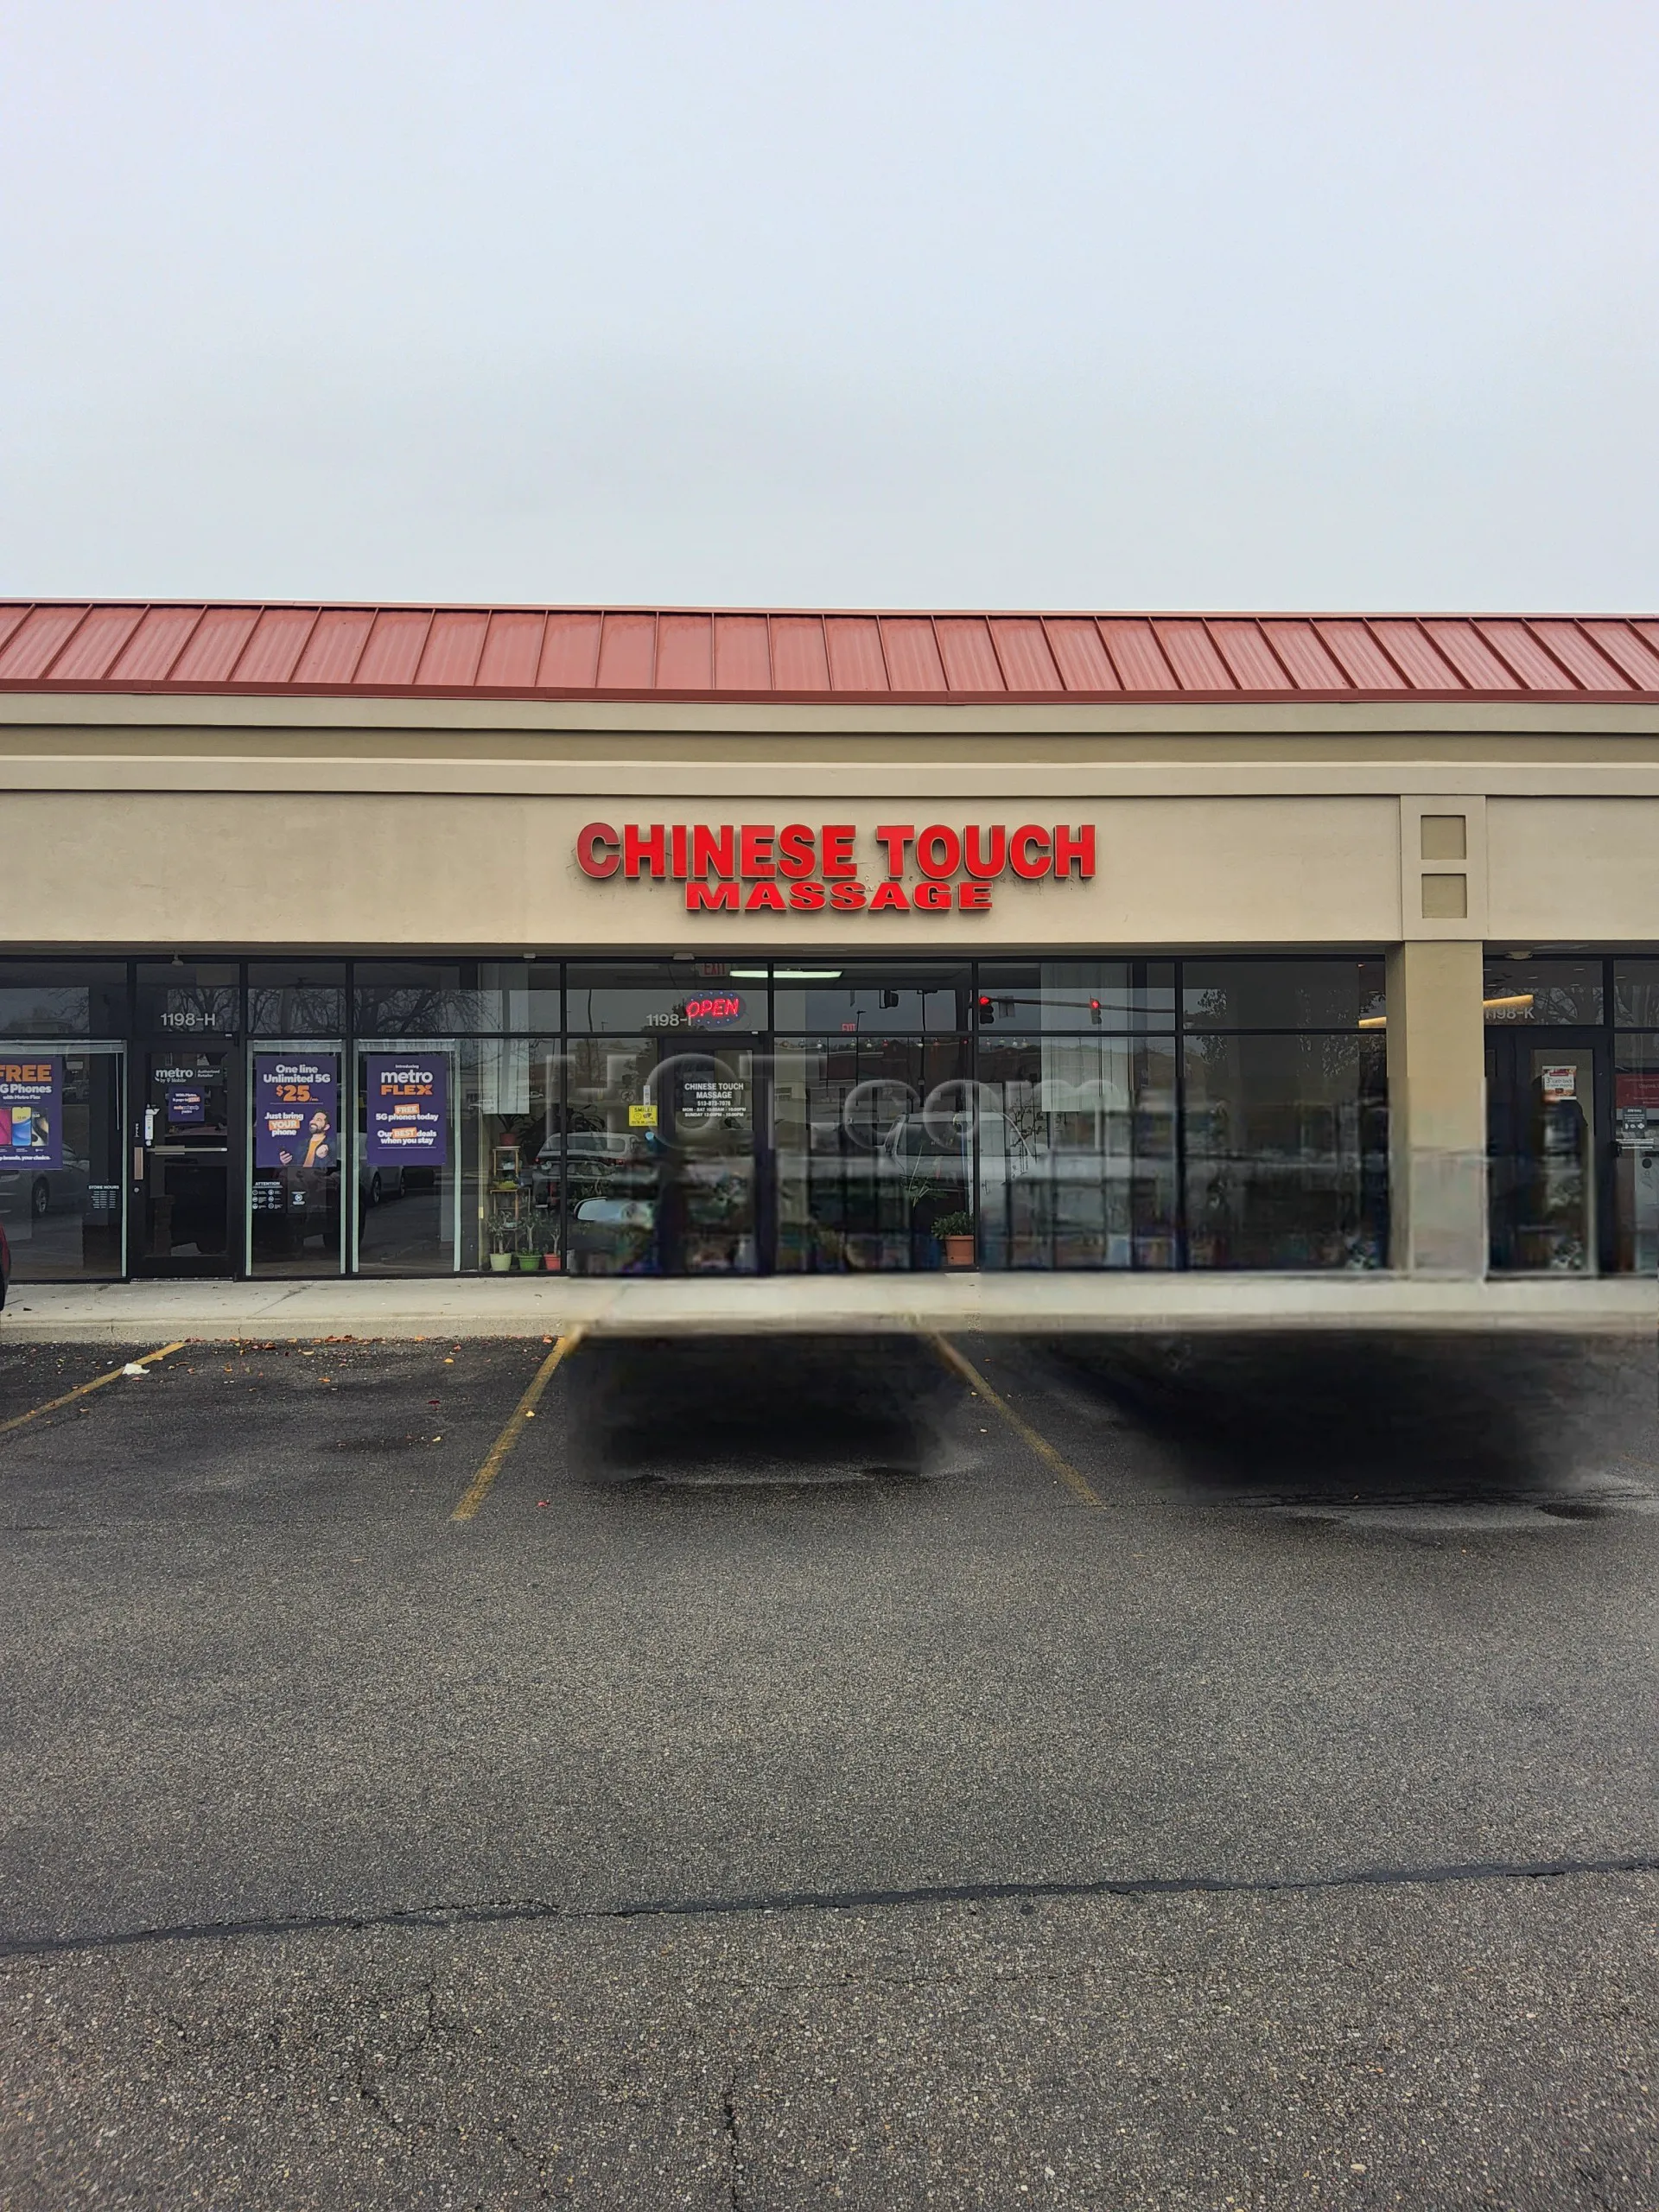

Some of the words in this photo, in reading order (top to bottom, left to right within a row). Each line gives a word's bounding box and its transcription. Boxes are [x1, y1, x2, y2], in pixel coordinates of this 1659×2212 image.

[576, 823, 858, 879] CHINESE
[875, 823, 1096, 880] TOUCH
[685, 881, 994, 911] MASSAGE
[686, 998, 740, 1017] OPEN
[1485, 1007, 1535, 1020] 1198-K
[160, 1013, 216, 1027] 1198-H
[156, 1068, 194, 1077] metro
[276, 1064, 298, 1073] One
[299, 1064, 319, 1073] line
[263, 1074, 313, 1084] Unlimited
[315, 1074, 331, 1083] 5G
[381, 1070, 433, 1084] metro
[10, 1084, 52, 1094] Phones
[276, 1084, 310, 1102] $25
[381, 1084, 433, 1096] FLEX
[283, 1112, 304, 1121] bring
[416, 1113, 439, 1122] today
[271, 1120, 297, 1128] YOUR
